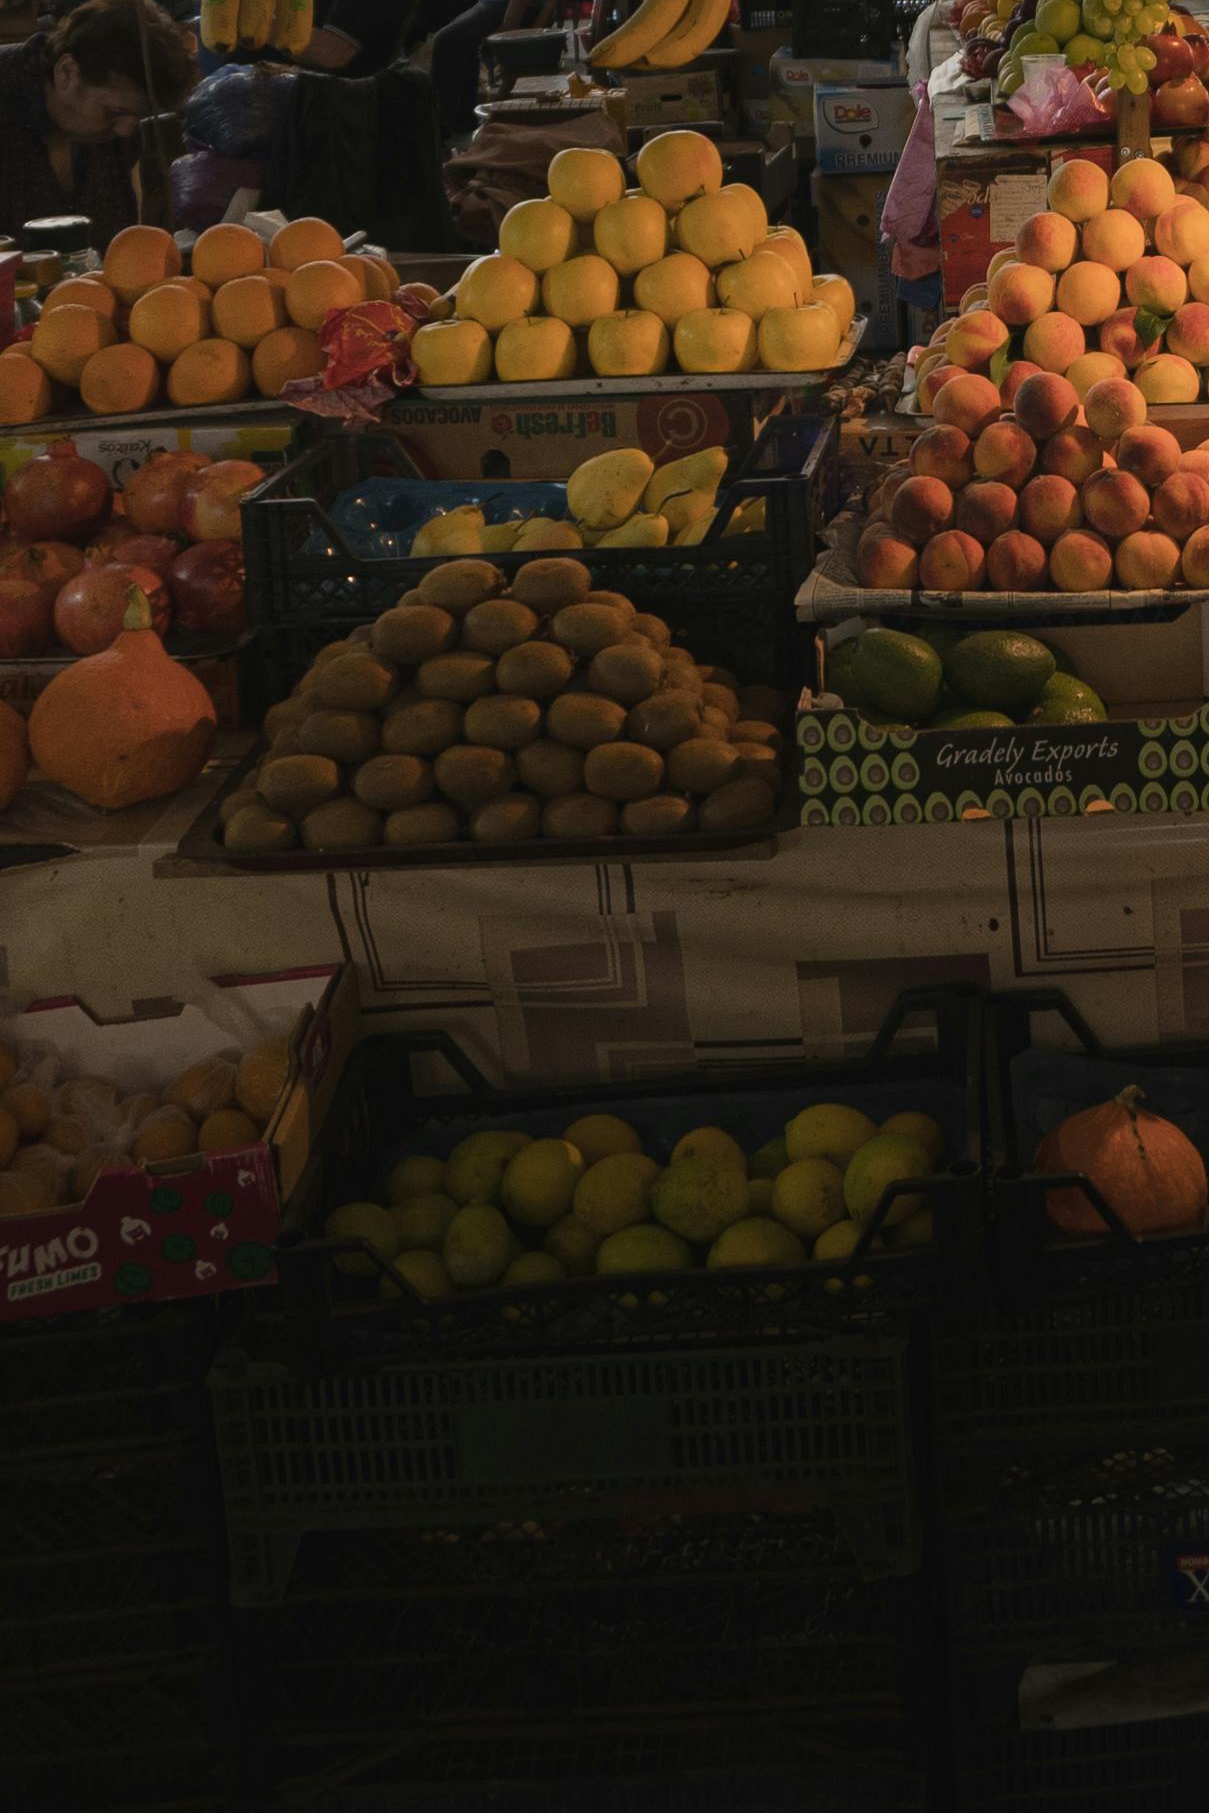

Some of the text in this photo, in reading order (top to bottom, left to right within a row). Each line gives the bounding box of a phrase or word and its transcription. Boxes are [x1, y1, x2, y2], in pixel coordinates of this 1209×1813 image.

[786, 69, 809, 82] Dole
[834, 103, 872, 120] Dole
[391, 405, 482, 425] AVOCADOS
[515, 411, 617, 439] BeFresh
[936, 735, 1120, 773] Gradely Exports
[994, 765, 1073, 786] Avocados
[10, 1264, 99, 1297] FRESH LIMES
